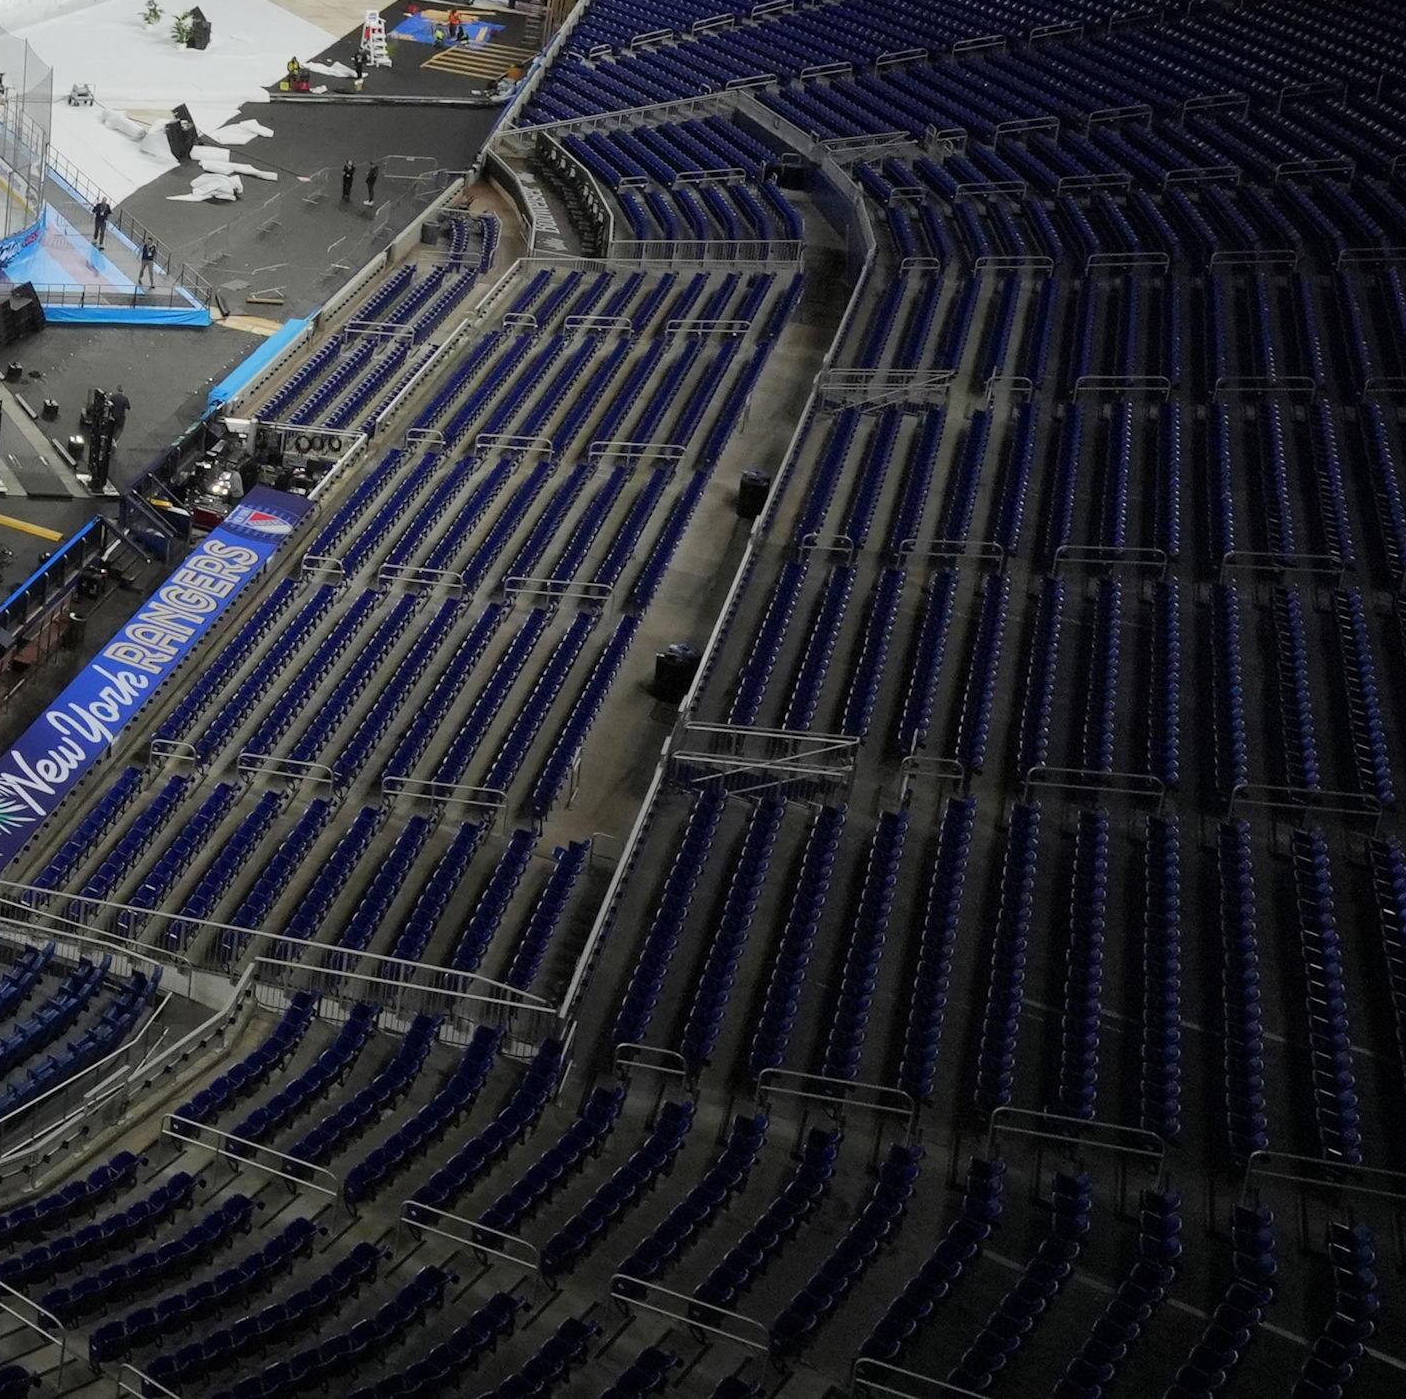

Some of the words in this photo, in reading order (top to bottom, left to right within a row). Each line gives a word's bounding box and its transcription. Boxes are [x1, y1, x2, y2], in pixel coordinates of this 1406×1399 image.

[0, 740, 86, 817] New
[46, 664, 149, 744] York
[103, 539, 259, 675] RANGERS
